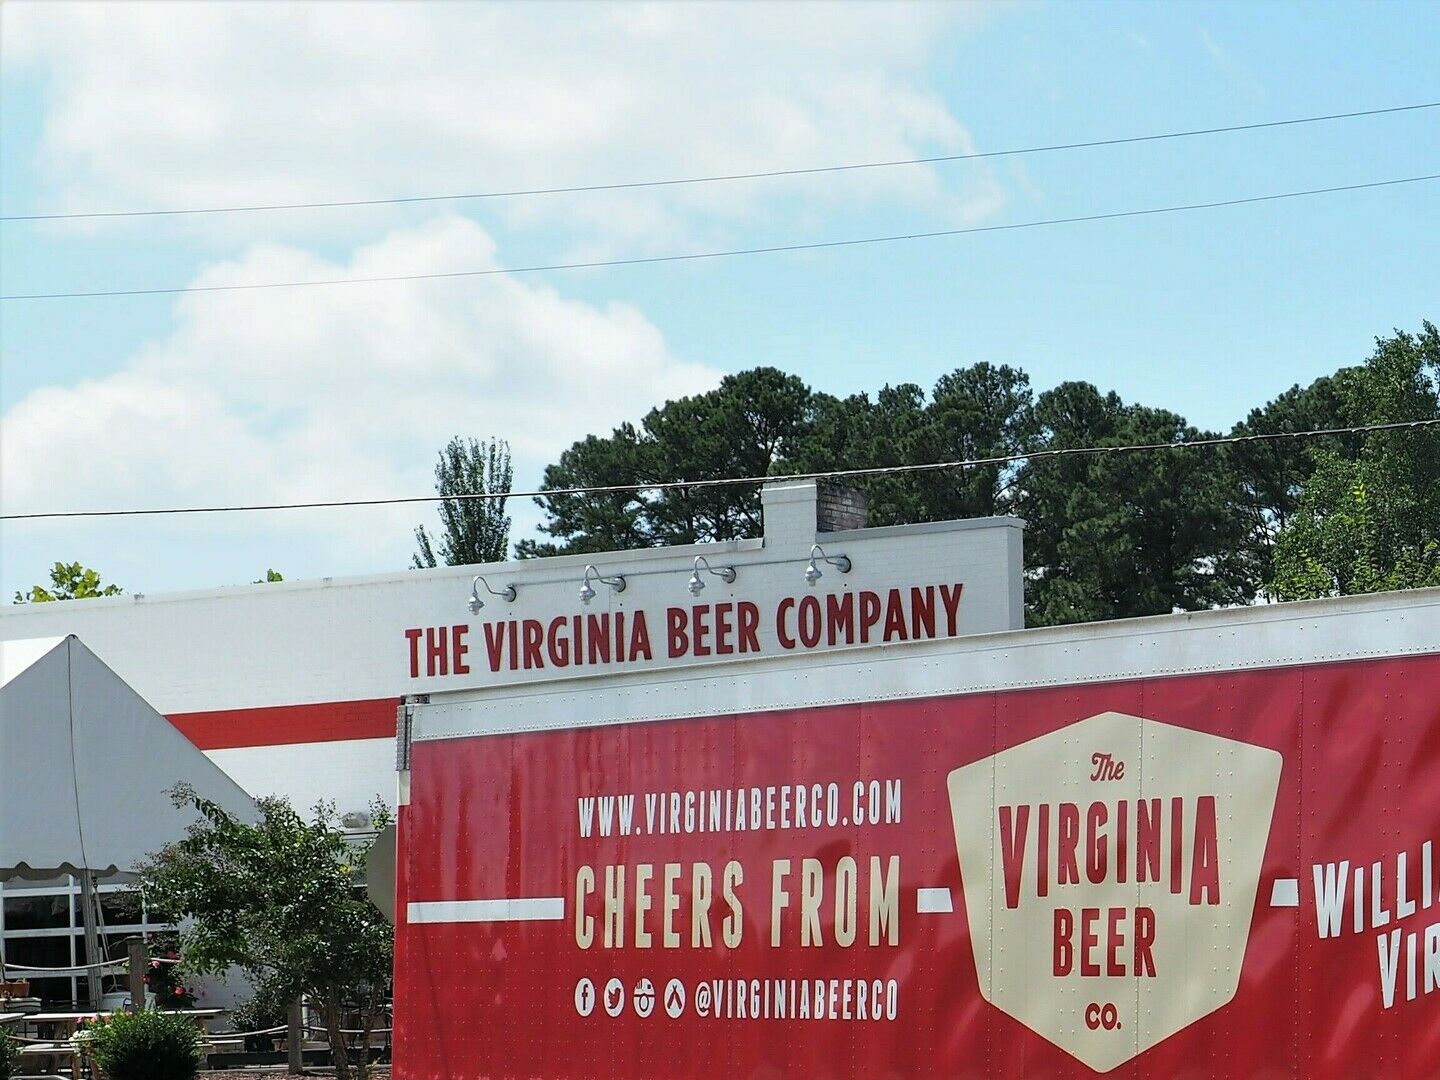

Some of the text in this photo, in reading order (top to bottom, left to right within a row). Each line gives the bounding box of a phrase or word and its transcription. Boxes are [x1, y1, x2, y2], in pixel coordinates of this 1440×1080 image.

[405, 583, 964, 677] THE VIRGINIA BEER COMPANY
[1090, 752, 1125, 782] The
[577, 778, 902, 838] WWW.VIRGINIABEERCO.COM
[998, 795, 1221, 909] VIRGINIA
[575, 855, 901, 949] CHEERS FROM
[1053, 907, 1157, 978] BEER
[694, 978, 898, 1022] @VIRGINIABEERCO
[1084, 1002, 1122, 1030] CO.
